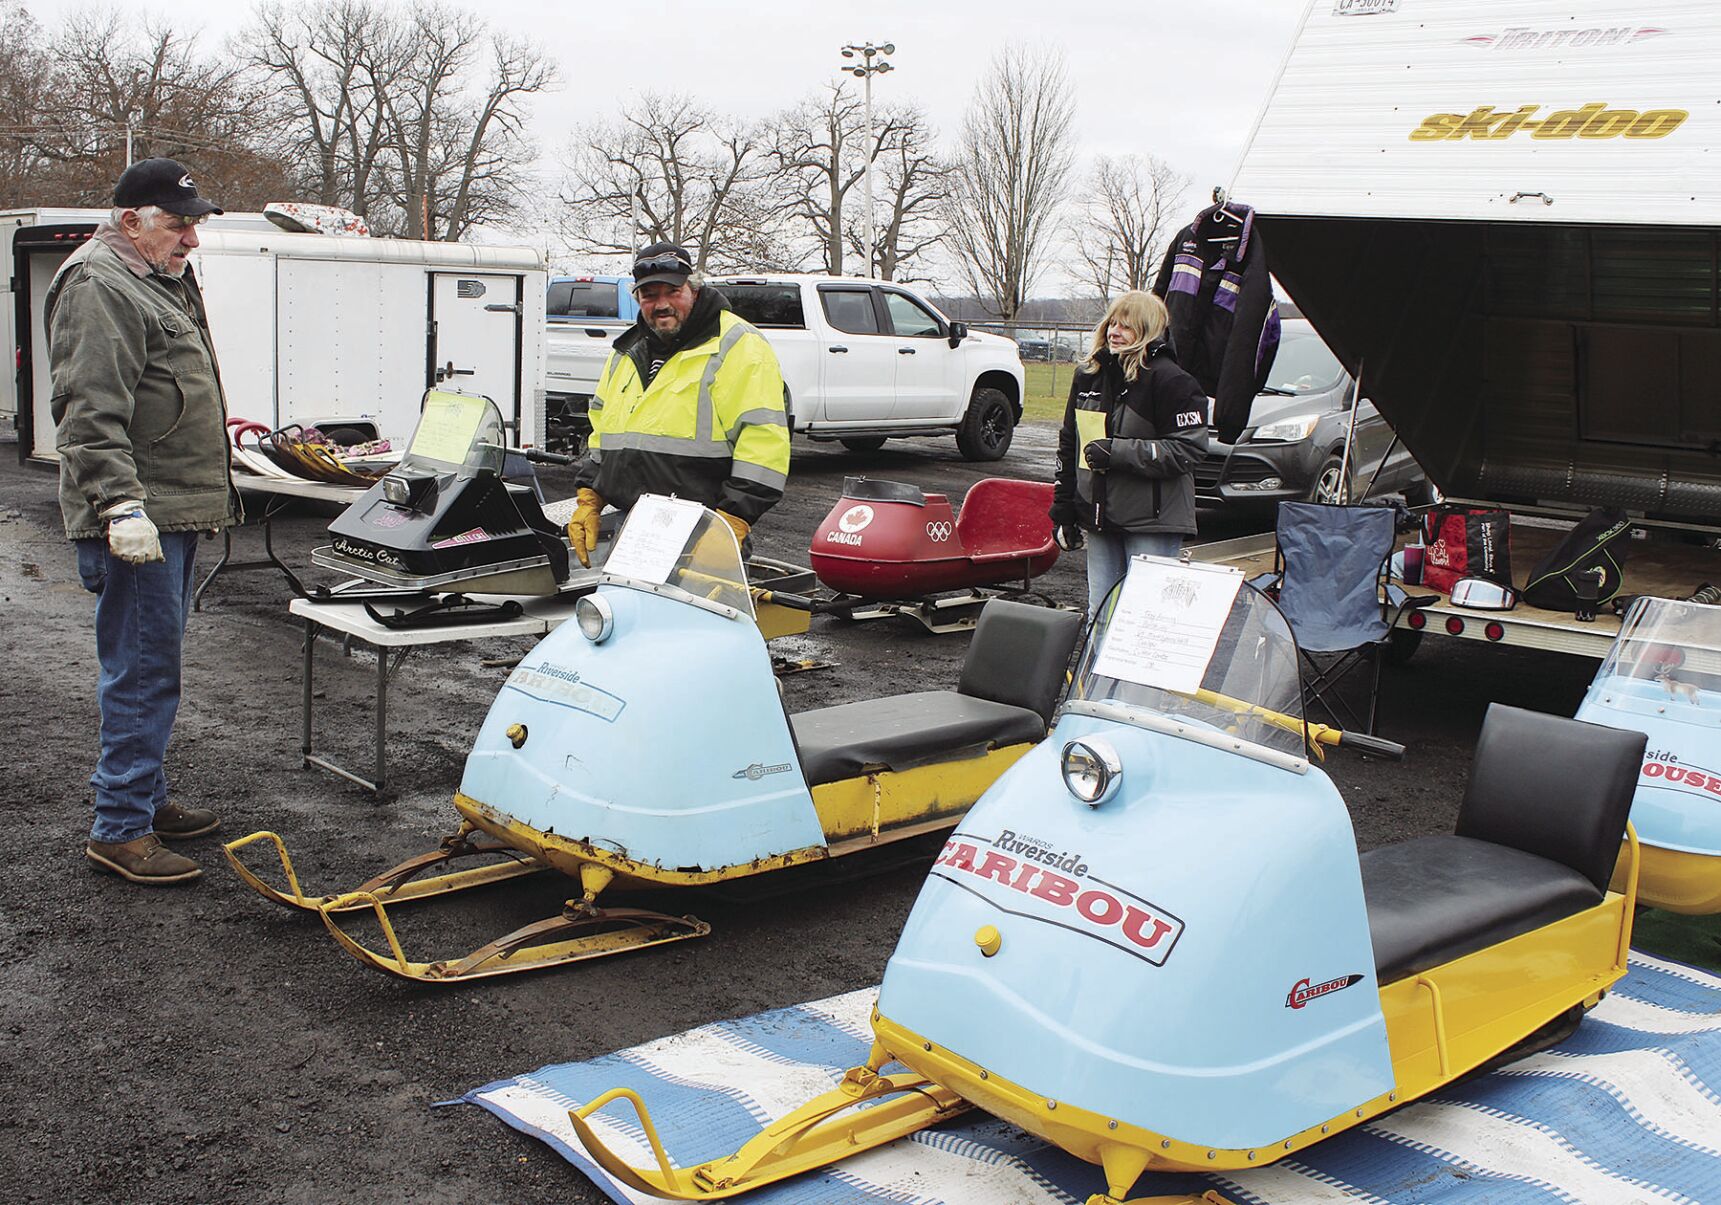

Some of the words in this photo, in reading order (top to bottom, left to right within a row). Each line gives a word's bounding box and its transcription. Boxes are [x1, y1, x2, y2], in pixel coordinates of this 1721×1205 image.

[1495, 27, 1632, 49] TRITON
[826, 532, 863, 547] CANADA
[335, 539, 374, 559] Arctic
[376, 550, 400, 566] Cat
[537, 661, 581, 684] Riverside
[992, 829, 1088, 877] Riverside
[1290, 978, 1348, 1010] CARIBOU
